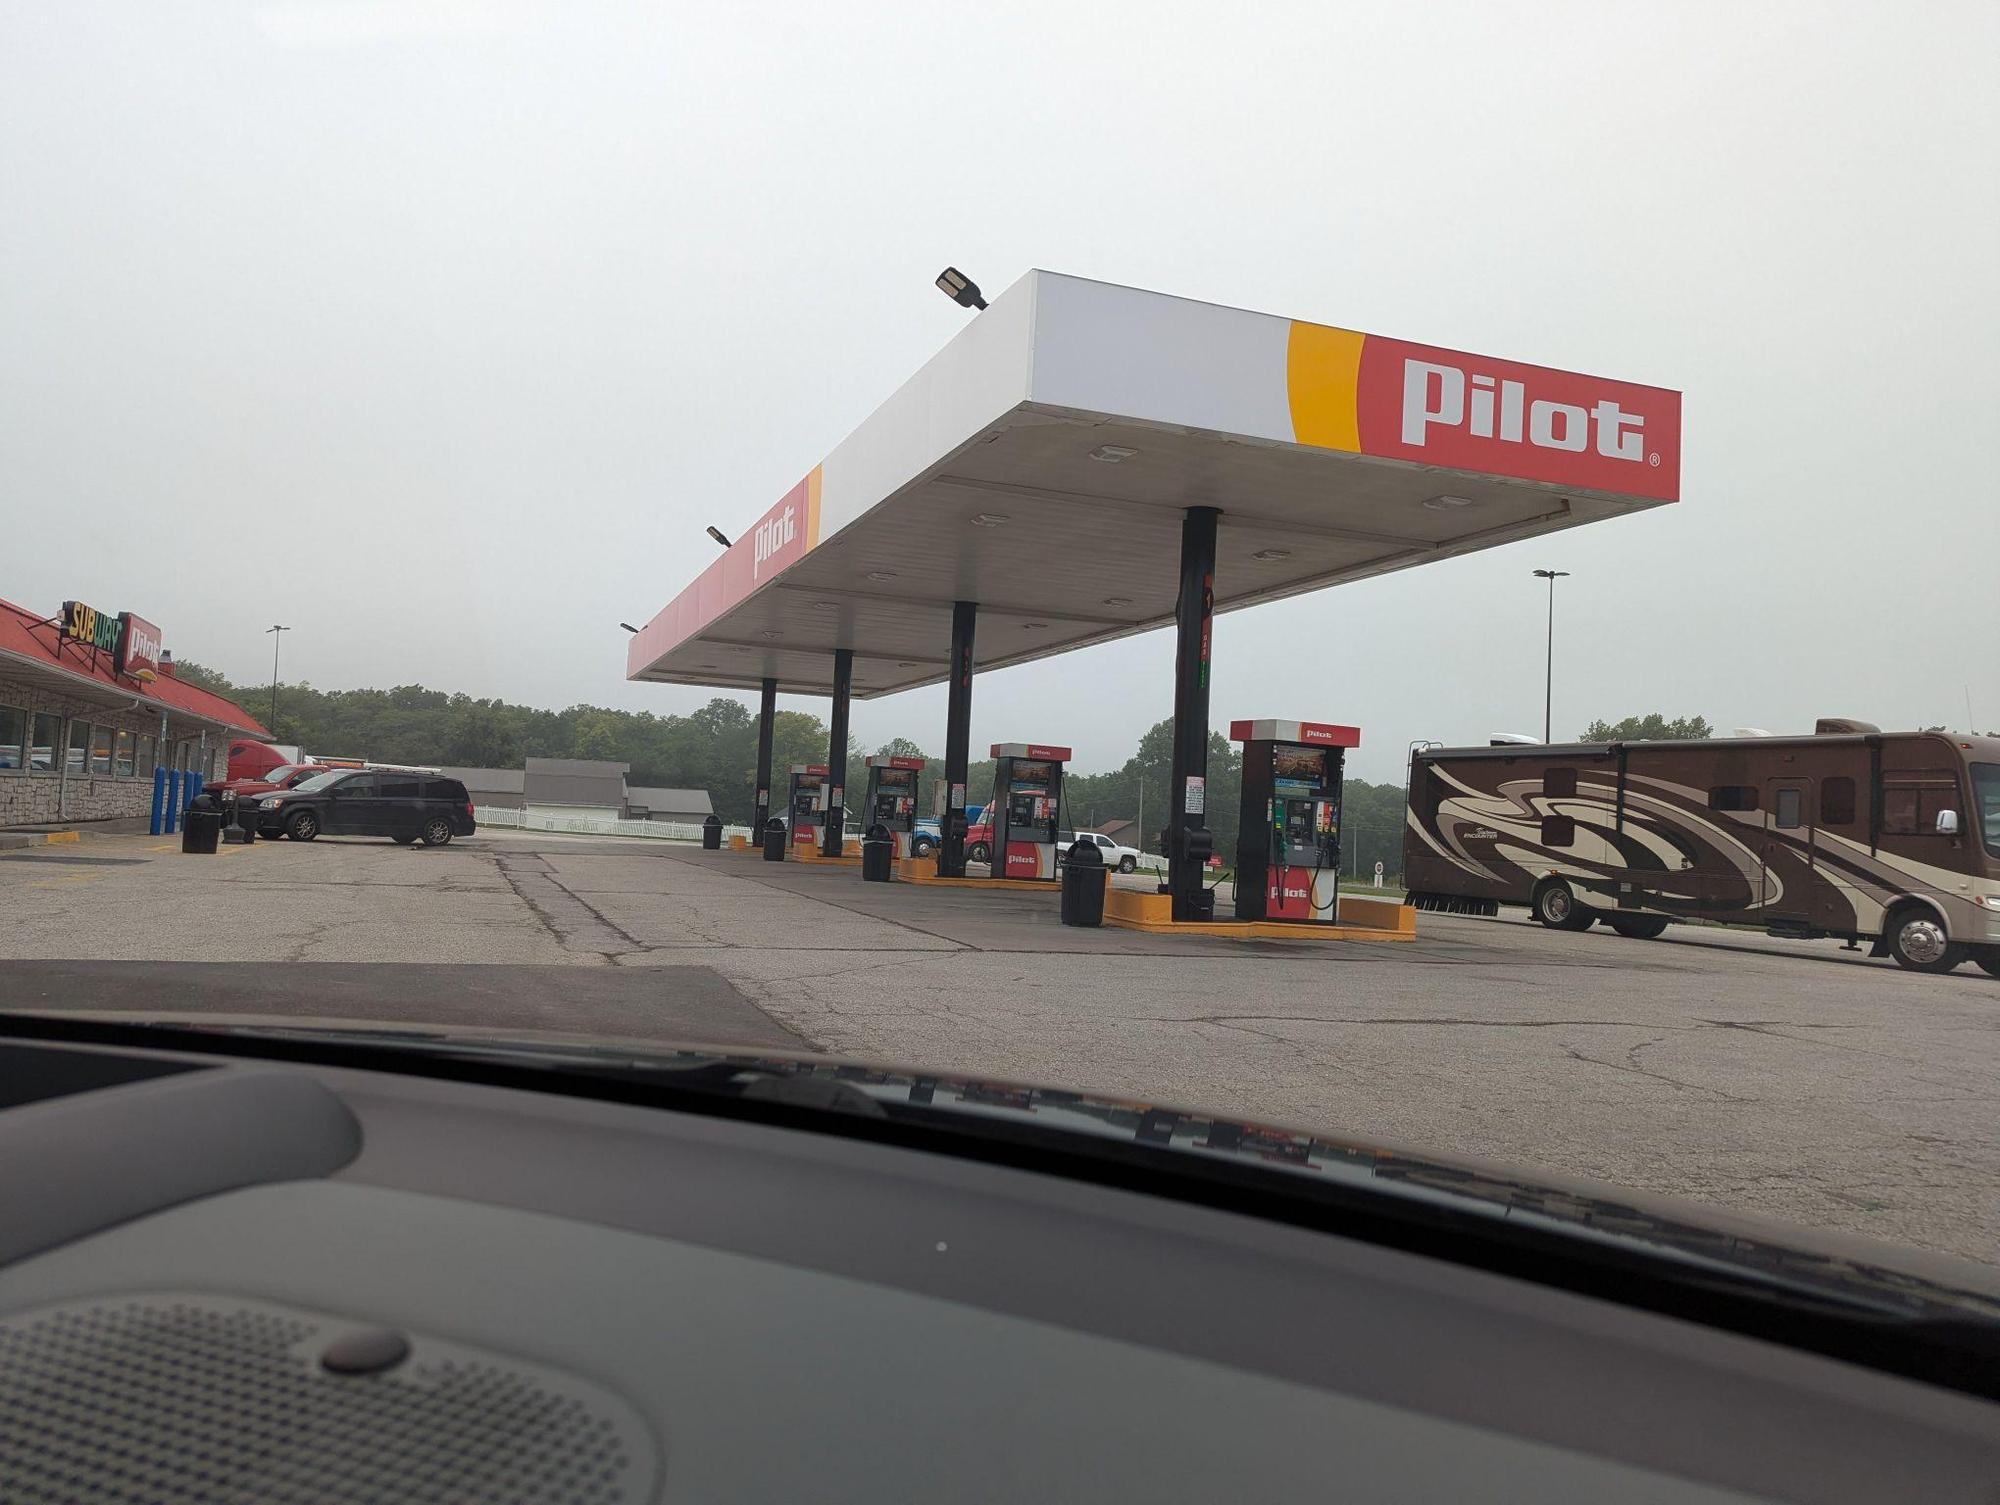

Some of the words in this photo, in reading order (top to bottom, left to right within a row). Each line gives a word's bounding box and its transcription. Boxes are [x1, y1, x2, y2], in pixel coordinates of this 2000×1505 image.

[1402, 358, 1645, 462] Pilot
[753, 504, 795, 580] Pilot
[69, 602, 123, 653] SUBWAY
[127, 626, 161, 665] Pilot
[1306, 729, 1333, 739] Pilot
[1008, 854, 1036, 864] Pilot
[1270, 886, 1307, 899] Plot
